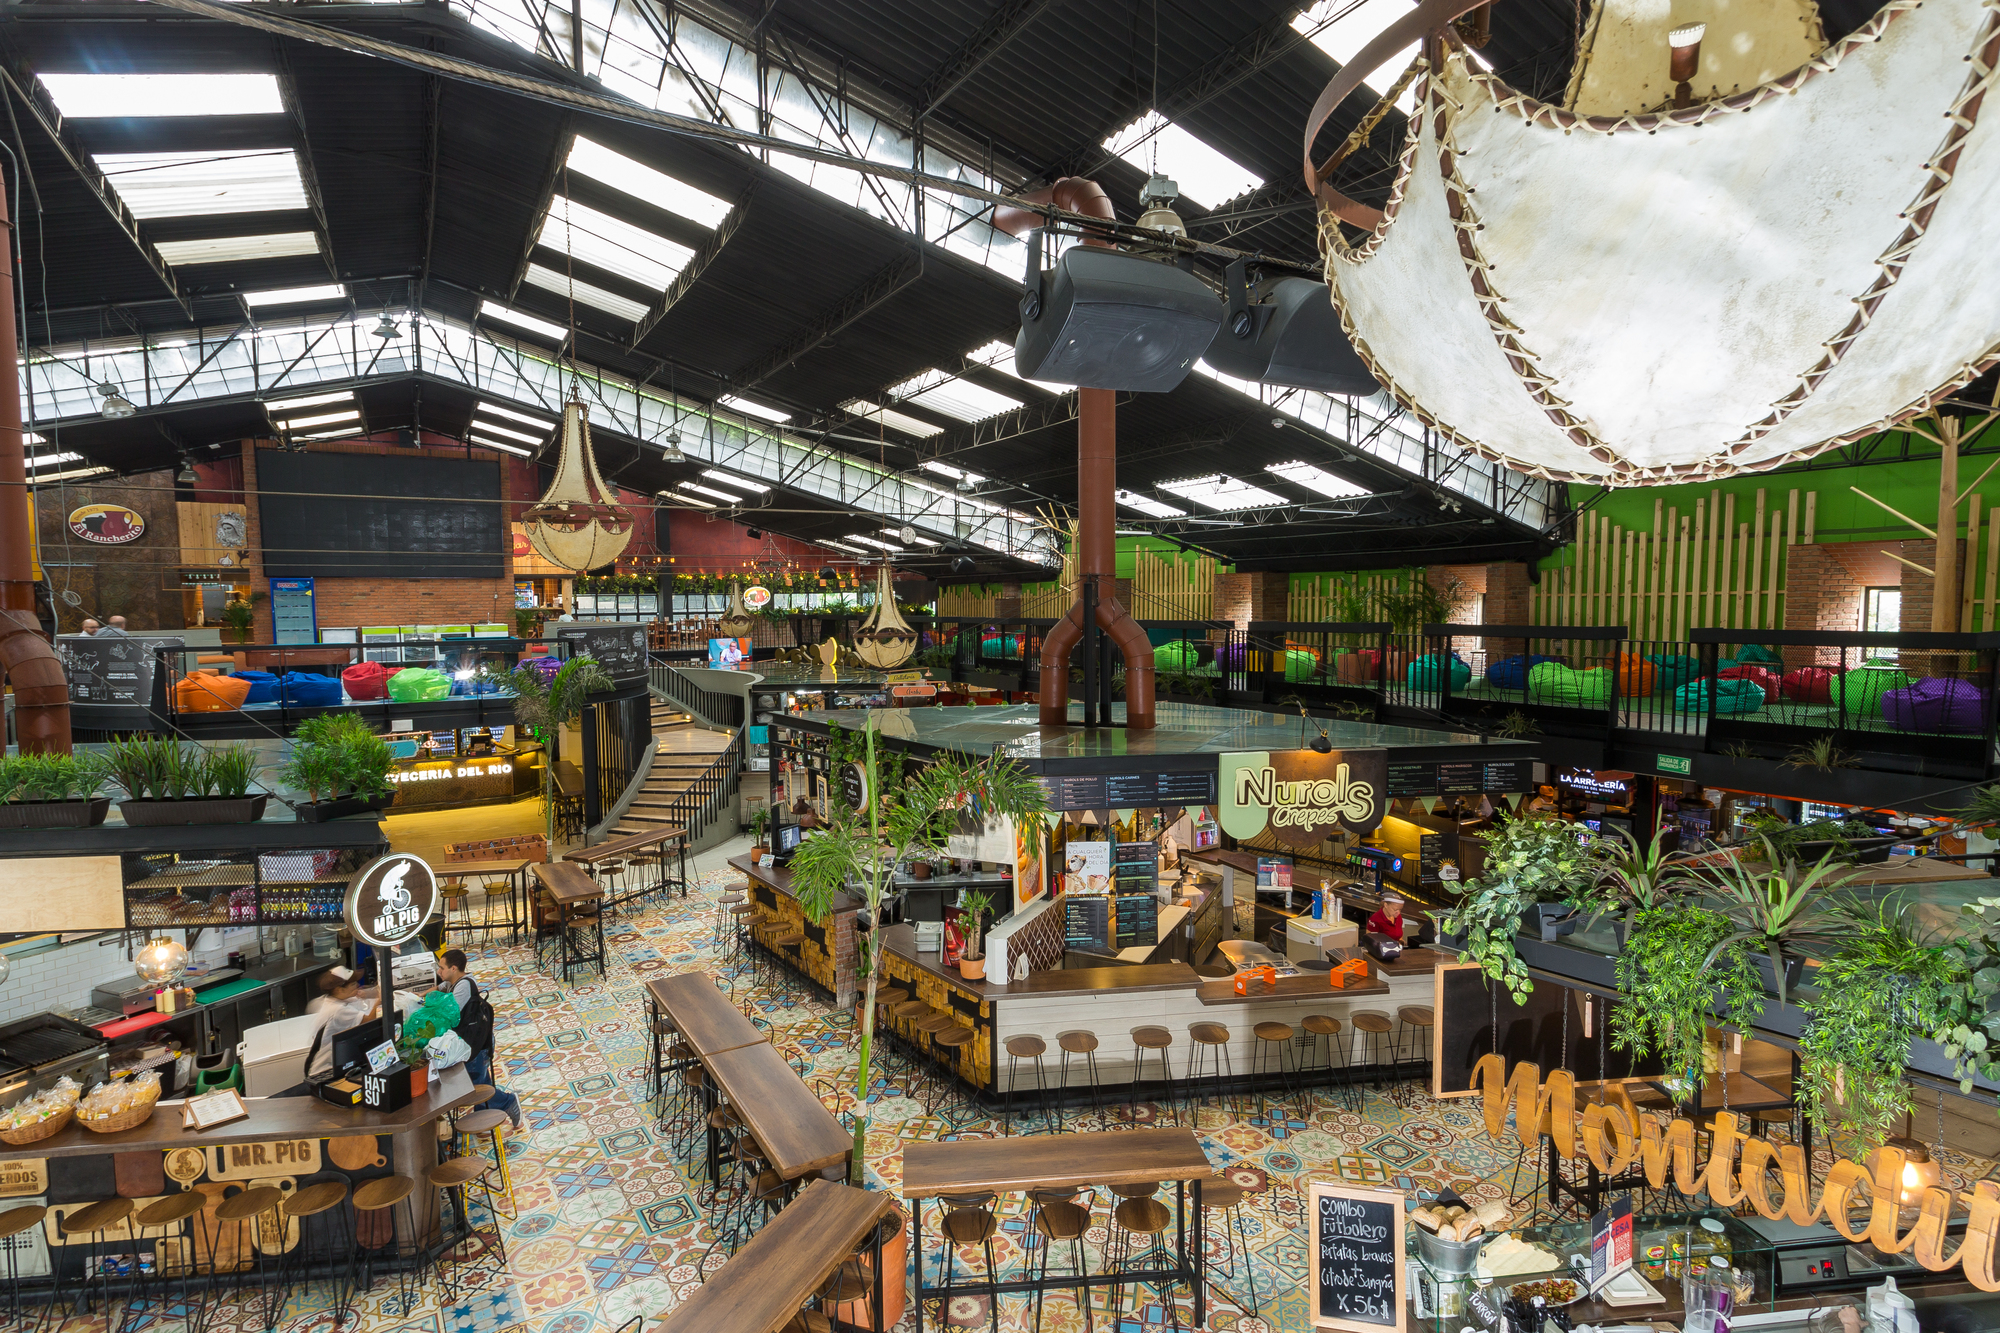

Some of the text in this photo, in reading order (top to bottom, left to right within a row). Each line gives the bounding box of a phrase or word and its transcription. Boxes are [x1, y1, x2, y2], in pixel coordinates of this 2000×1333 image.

[73, 523, 141, 542] El Rancherito
[513, 541, 529, 550] ar
[457, 766, 484, 778] DEL
[488, 764, 512, 775] RIO
[1560, 774, 1572, 783] LA
[1234, 763, 1374, 823] Nurols
[1272, 805, 1338, 832] Crepes
[373, 914, 398, 935] MR.
[398, 907, 420, 926] PIG
[364, 1074, 387, 1094] HAT
[364, 1089, 380, 1107] SU
[231, 1140, 312, 1168] MR. PIG
[3, 1161, 24, 1170] 100%
[1319, 1198, 1366, 1218] Combo
[1322, 1215, 1388, 1239] Futbolero
[1320, 1243, 1395, 1265] Patatas bravas
